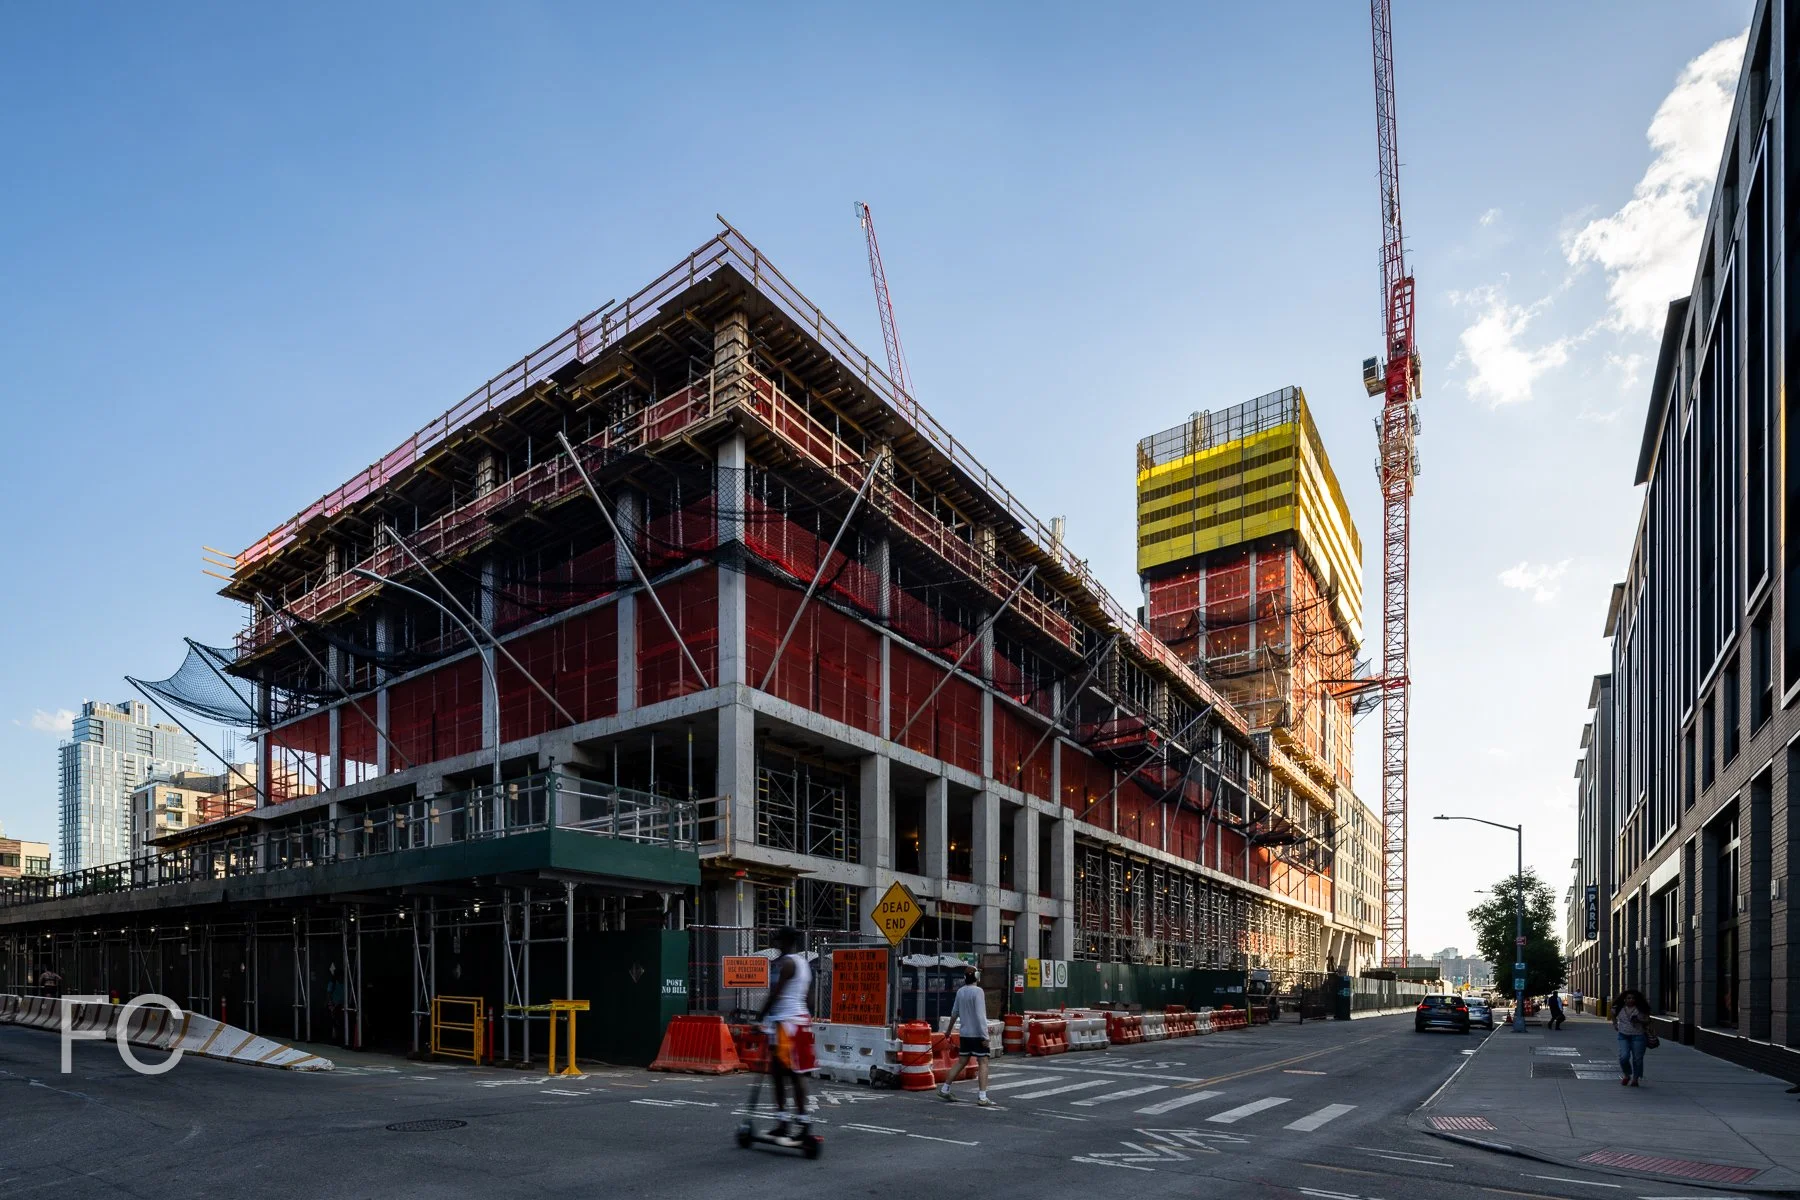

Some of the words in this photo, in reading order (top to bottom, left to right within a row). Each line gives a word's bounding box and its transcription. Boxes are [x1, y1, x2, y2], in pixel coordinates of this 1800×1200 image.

[882, 902, 910, 912] DEAD
[886, 918, 906, 930] END
[860, 962, 874, 970] DEAD
[840, 972, 852, 981] WILL
[860, 972, 880, 981] CLOSED
[839, 983, 844, 992] TO
[860, 983, 880, 992] TRAFFIC
[842, 1013, 868, 1022] ALTERNATE
